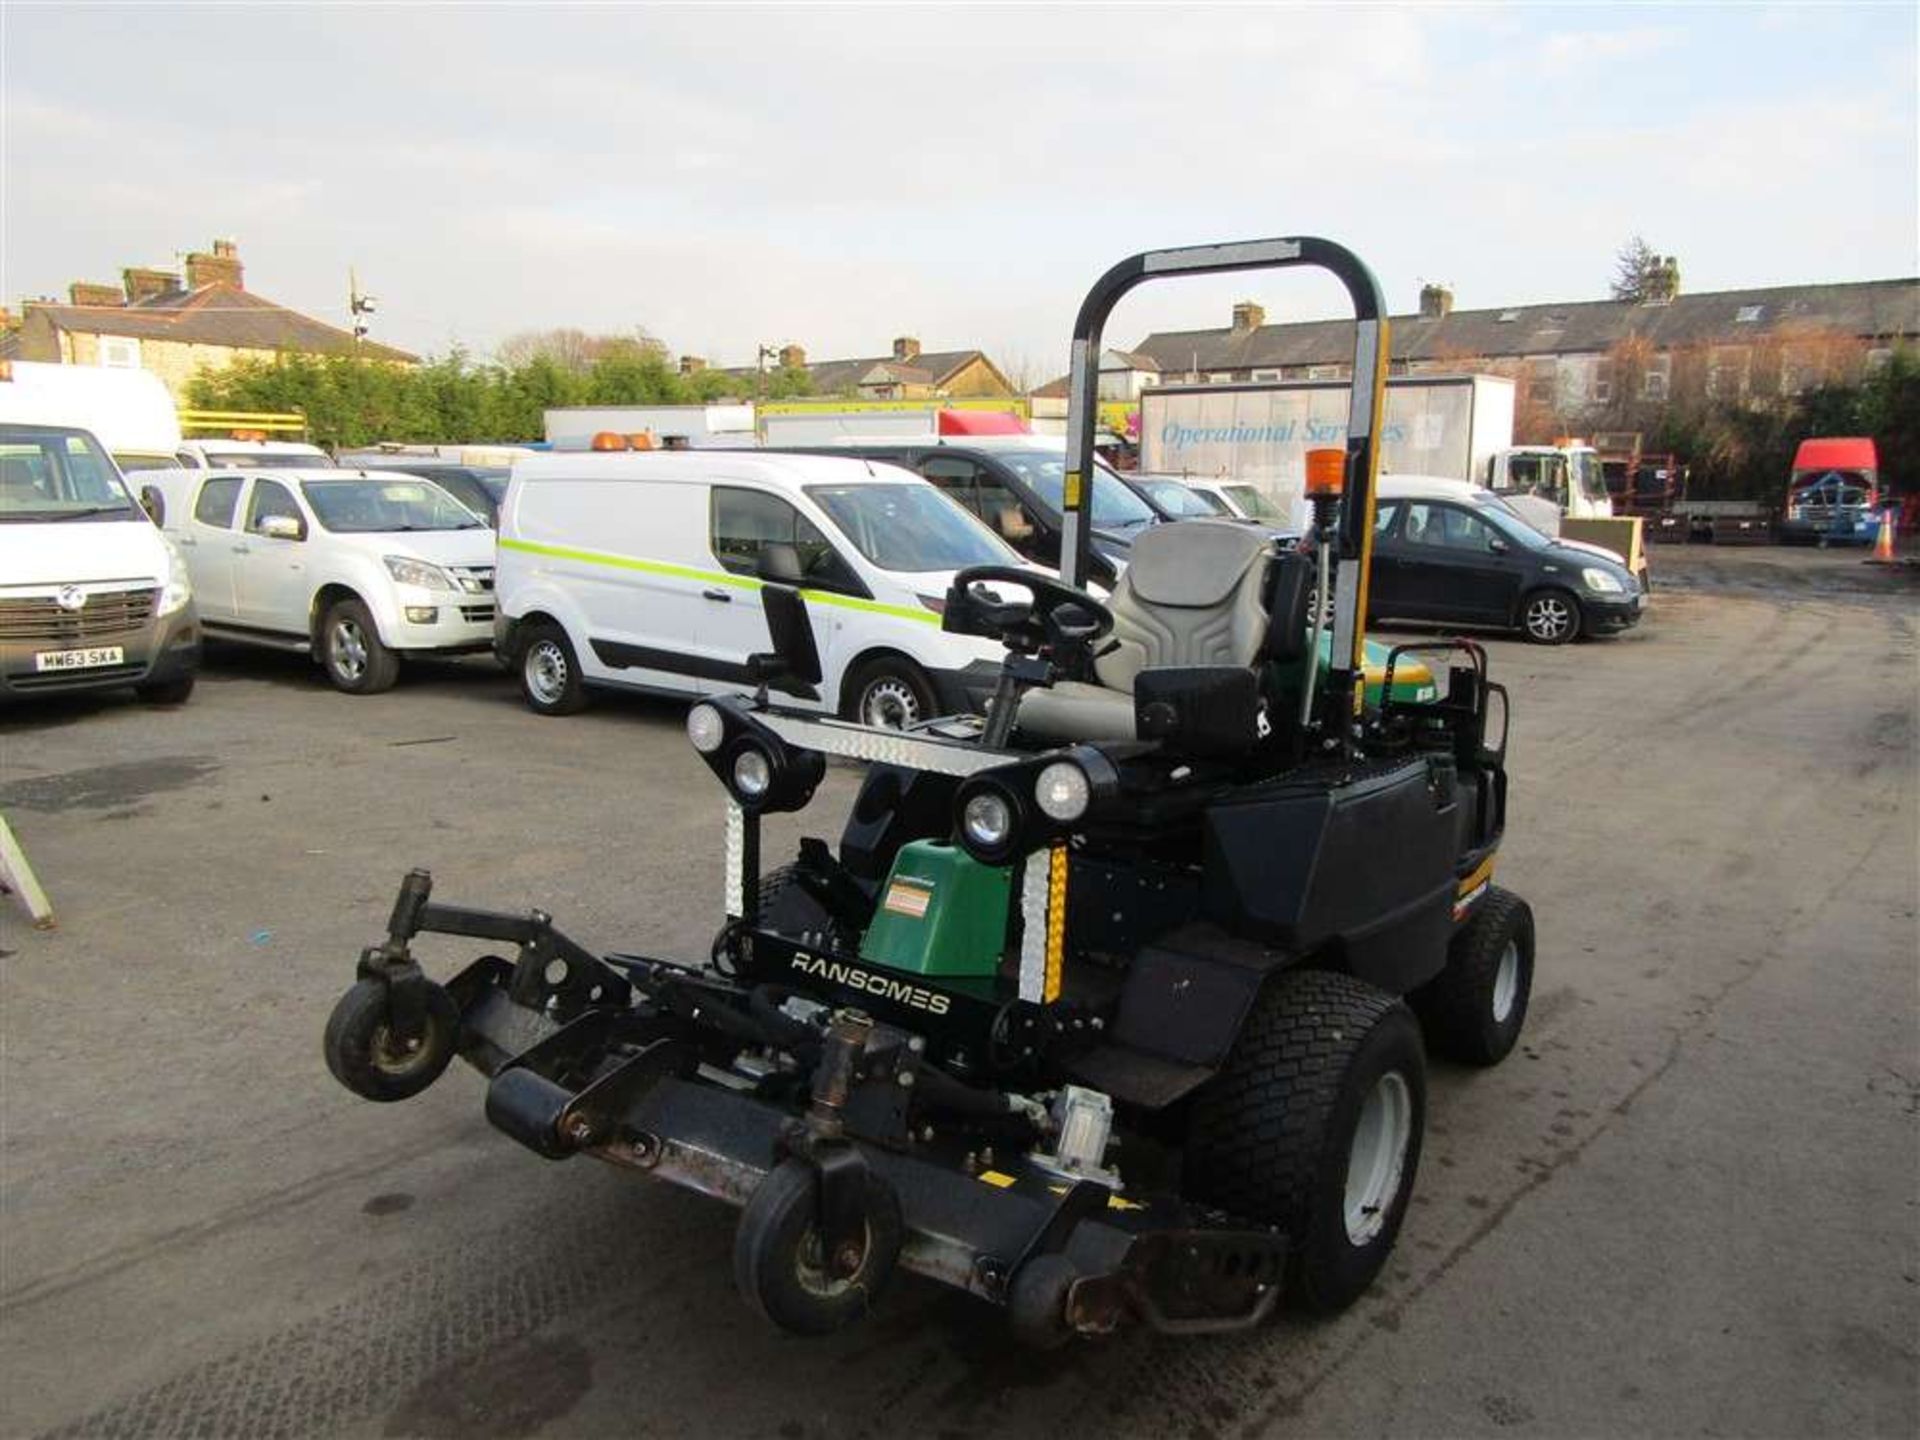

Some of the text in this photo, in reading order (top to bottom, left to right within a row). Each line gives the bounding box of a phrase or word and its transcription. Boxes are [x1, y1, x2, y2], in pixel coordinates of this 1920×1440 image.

[1162, 417, 1405, 449] Operational Seres
[44, 652, 86, 668] MW63
[791, 952, 951, 1015] RANSOMES
